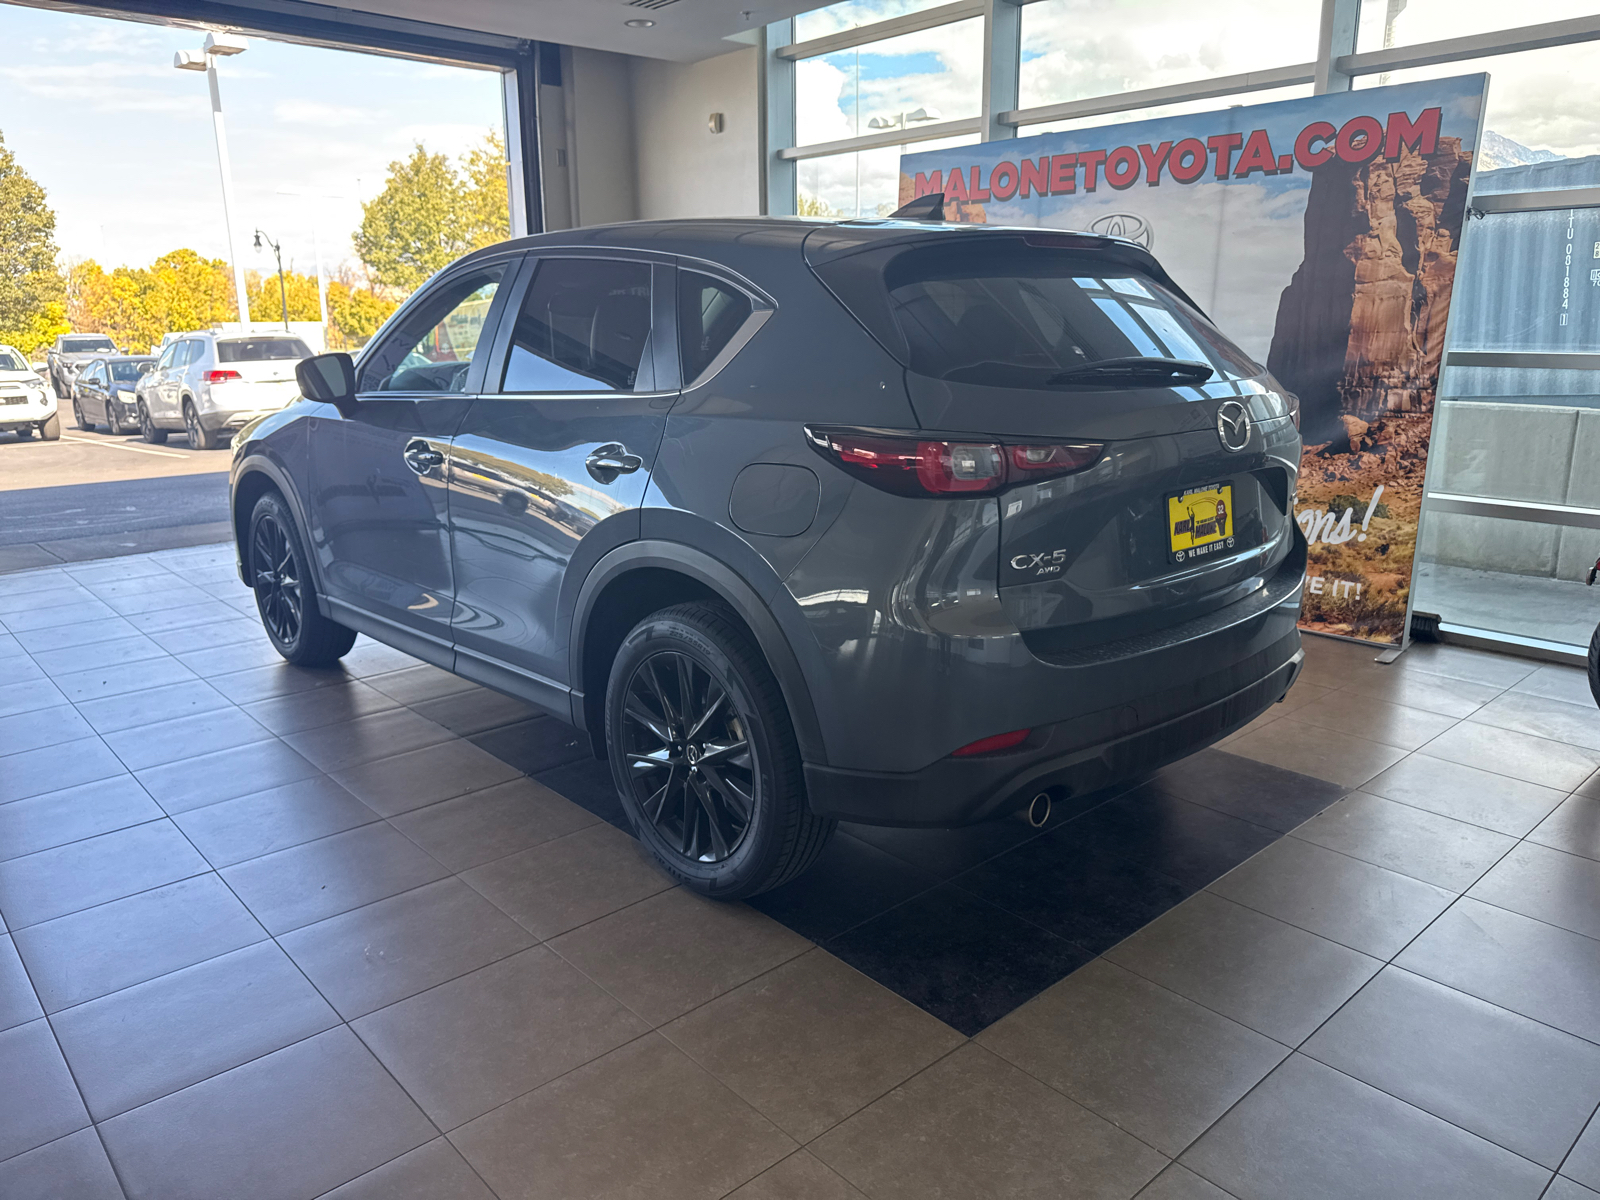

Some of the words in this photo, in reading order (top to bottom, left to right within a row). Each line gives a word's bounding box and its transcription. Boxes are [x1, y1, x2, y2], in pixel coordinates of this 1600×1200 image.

[914, 107, 1442, 203] MALONETOYOTA.COM
[1561, 243, 1572, 310] 081884
[1217, 504, 1224, 514] 32
[1010, 548, 1067, 570] CX-5
[1188, 550, 1196, 558] WE
[1196, 545, 1209, 556] MAKE
[1208, 544, 1214, 552] IT
[1213, 541, 1224, 551] EASY
[1036, 565, 1061, 576] AWD
[1332, 579, 1361, 601] IT!
